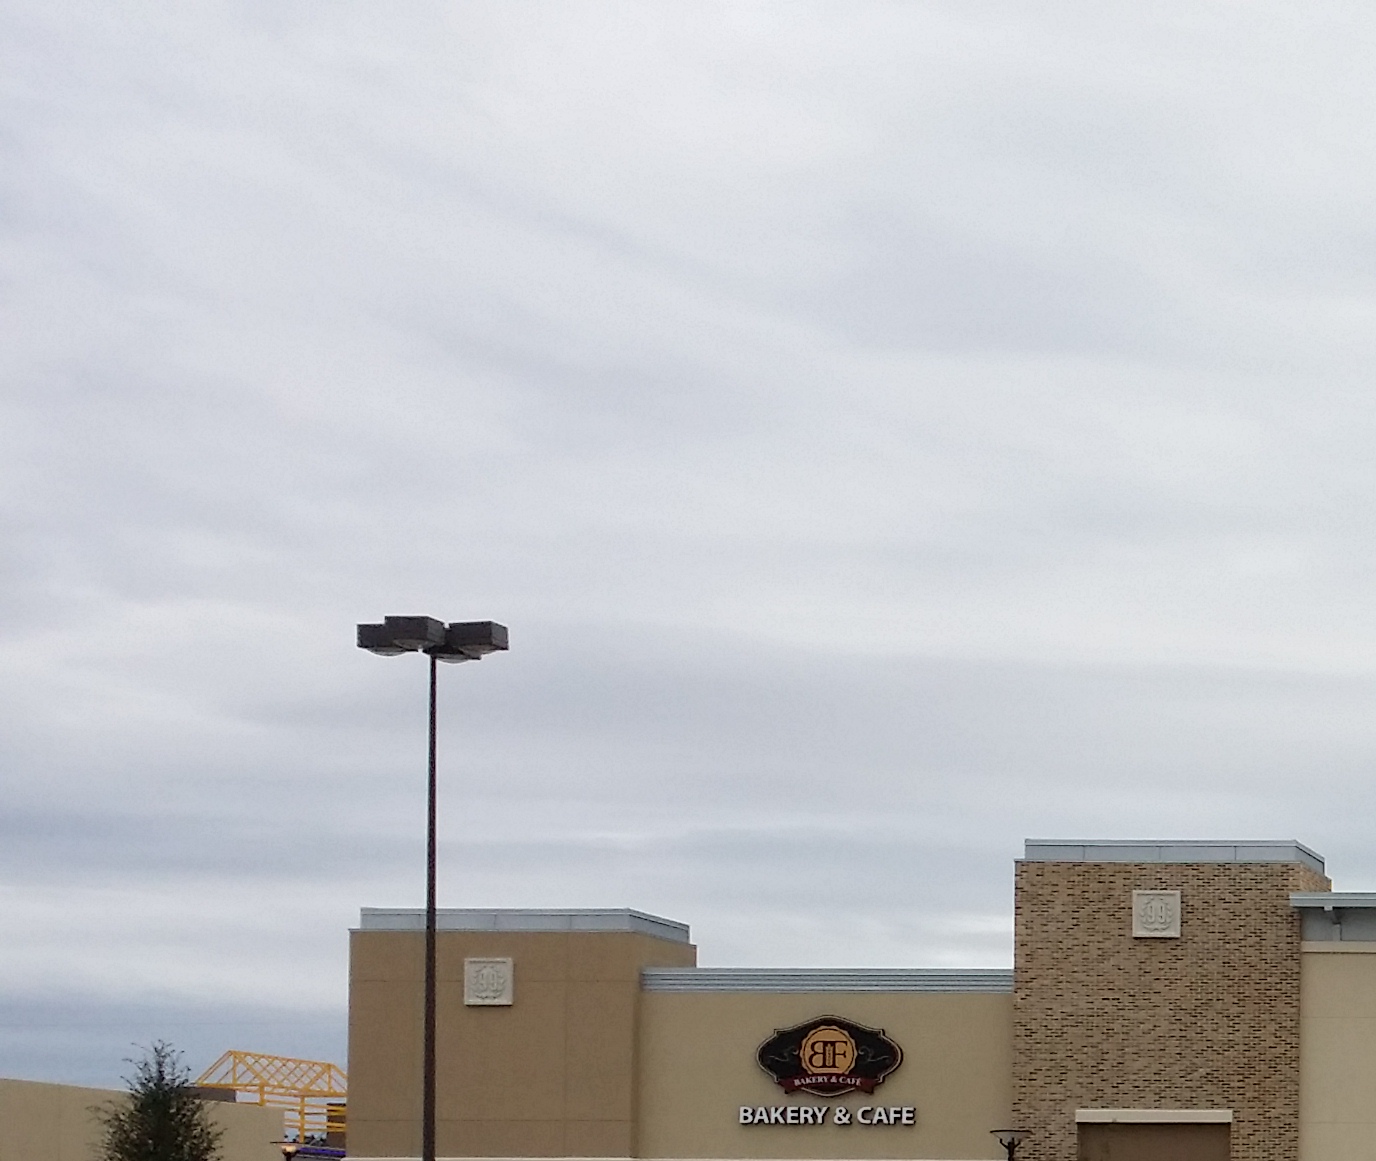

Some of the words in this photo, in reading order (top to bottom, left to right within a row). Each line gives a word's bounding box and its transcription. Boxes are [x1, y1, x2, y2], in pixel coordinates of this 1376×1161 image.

[739, 1106, 828, 1124] BAKERY
[833, 1106, 851, 1124] &
[856, 1106, 915, 1124] CAFE
